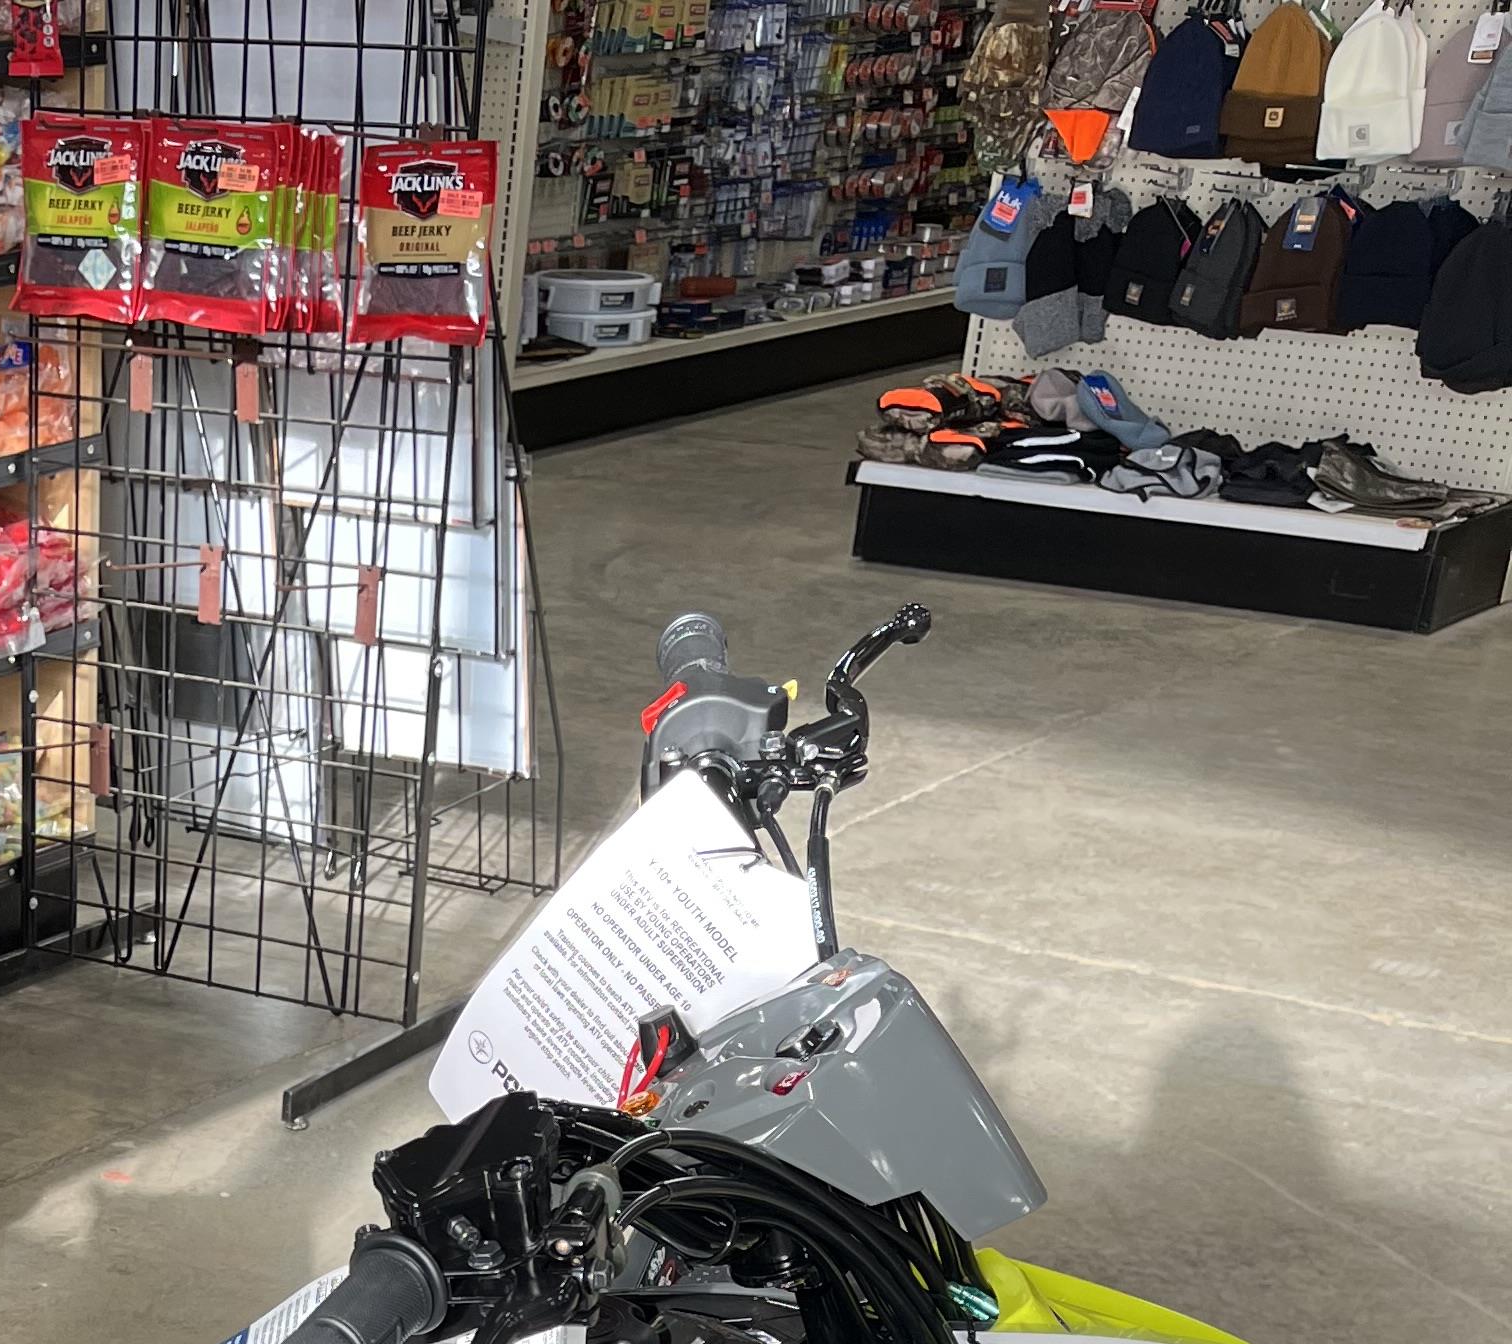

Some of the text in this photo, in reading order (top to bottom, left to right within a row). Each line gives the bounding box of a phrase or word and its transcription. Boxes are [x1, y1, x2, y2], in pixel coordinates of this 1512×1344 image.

[47, 150, 78, 167] JACK
[176, 152, 210, 172] JACK
[389, 175, 422, 193] JACK
[48, 198, 103, 211] BEEF JERKY
[177, 203, 232, 219] BEEF JERKY
[392, 225, 451, 237] BEEF JERKY
[400, 242, 439, 252] ORIGINAL
[565, 906, 605, 950] OPERATOR
[600, 945, 624, 970] ONLY
[622, 970, 638, 986] NO
[609, 887, 707, 995] UNDER ADULT SUPERVISION
[618, 880, 716, 989] USE BY YOUNG OPERATORS
[637, 884, 654, 902] ATV
[658, 907, 672, 922] for
[668, 919, 727, 984] RECREATIONAL
[670, 884, 707, 924] YOUTH
[701, 920, 741, 963] MODEL
[554, 928, 581, 956] Training
[576, 952, 601, 979] courses
[598, 976, 608, 986] to
[620, 1000, 635, 1017] ATV
[590, 901, 692, 1012] NO OPERATOR UNDER AGE 10
[529, 945, 549, 966] Check
[545, 963, 560, 978] with
[571, 992, 589, 1011] dealer
[591, 1014, 606, 1030] find
[576, 966, 610, 1003] information
[605, 999, 630, 1025] contact
[555, 1033, 570, 1048] ATV
[561, 997, 591, 1029] regarding
[588, 1024, 603, 1040] ATV
